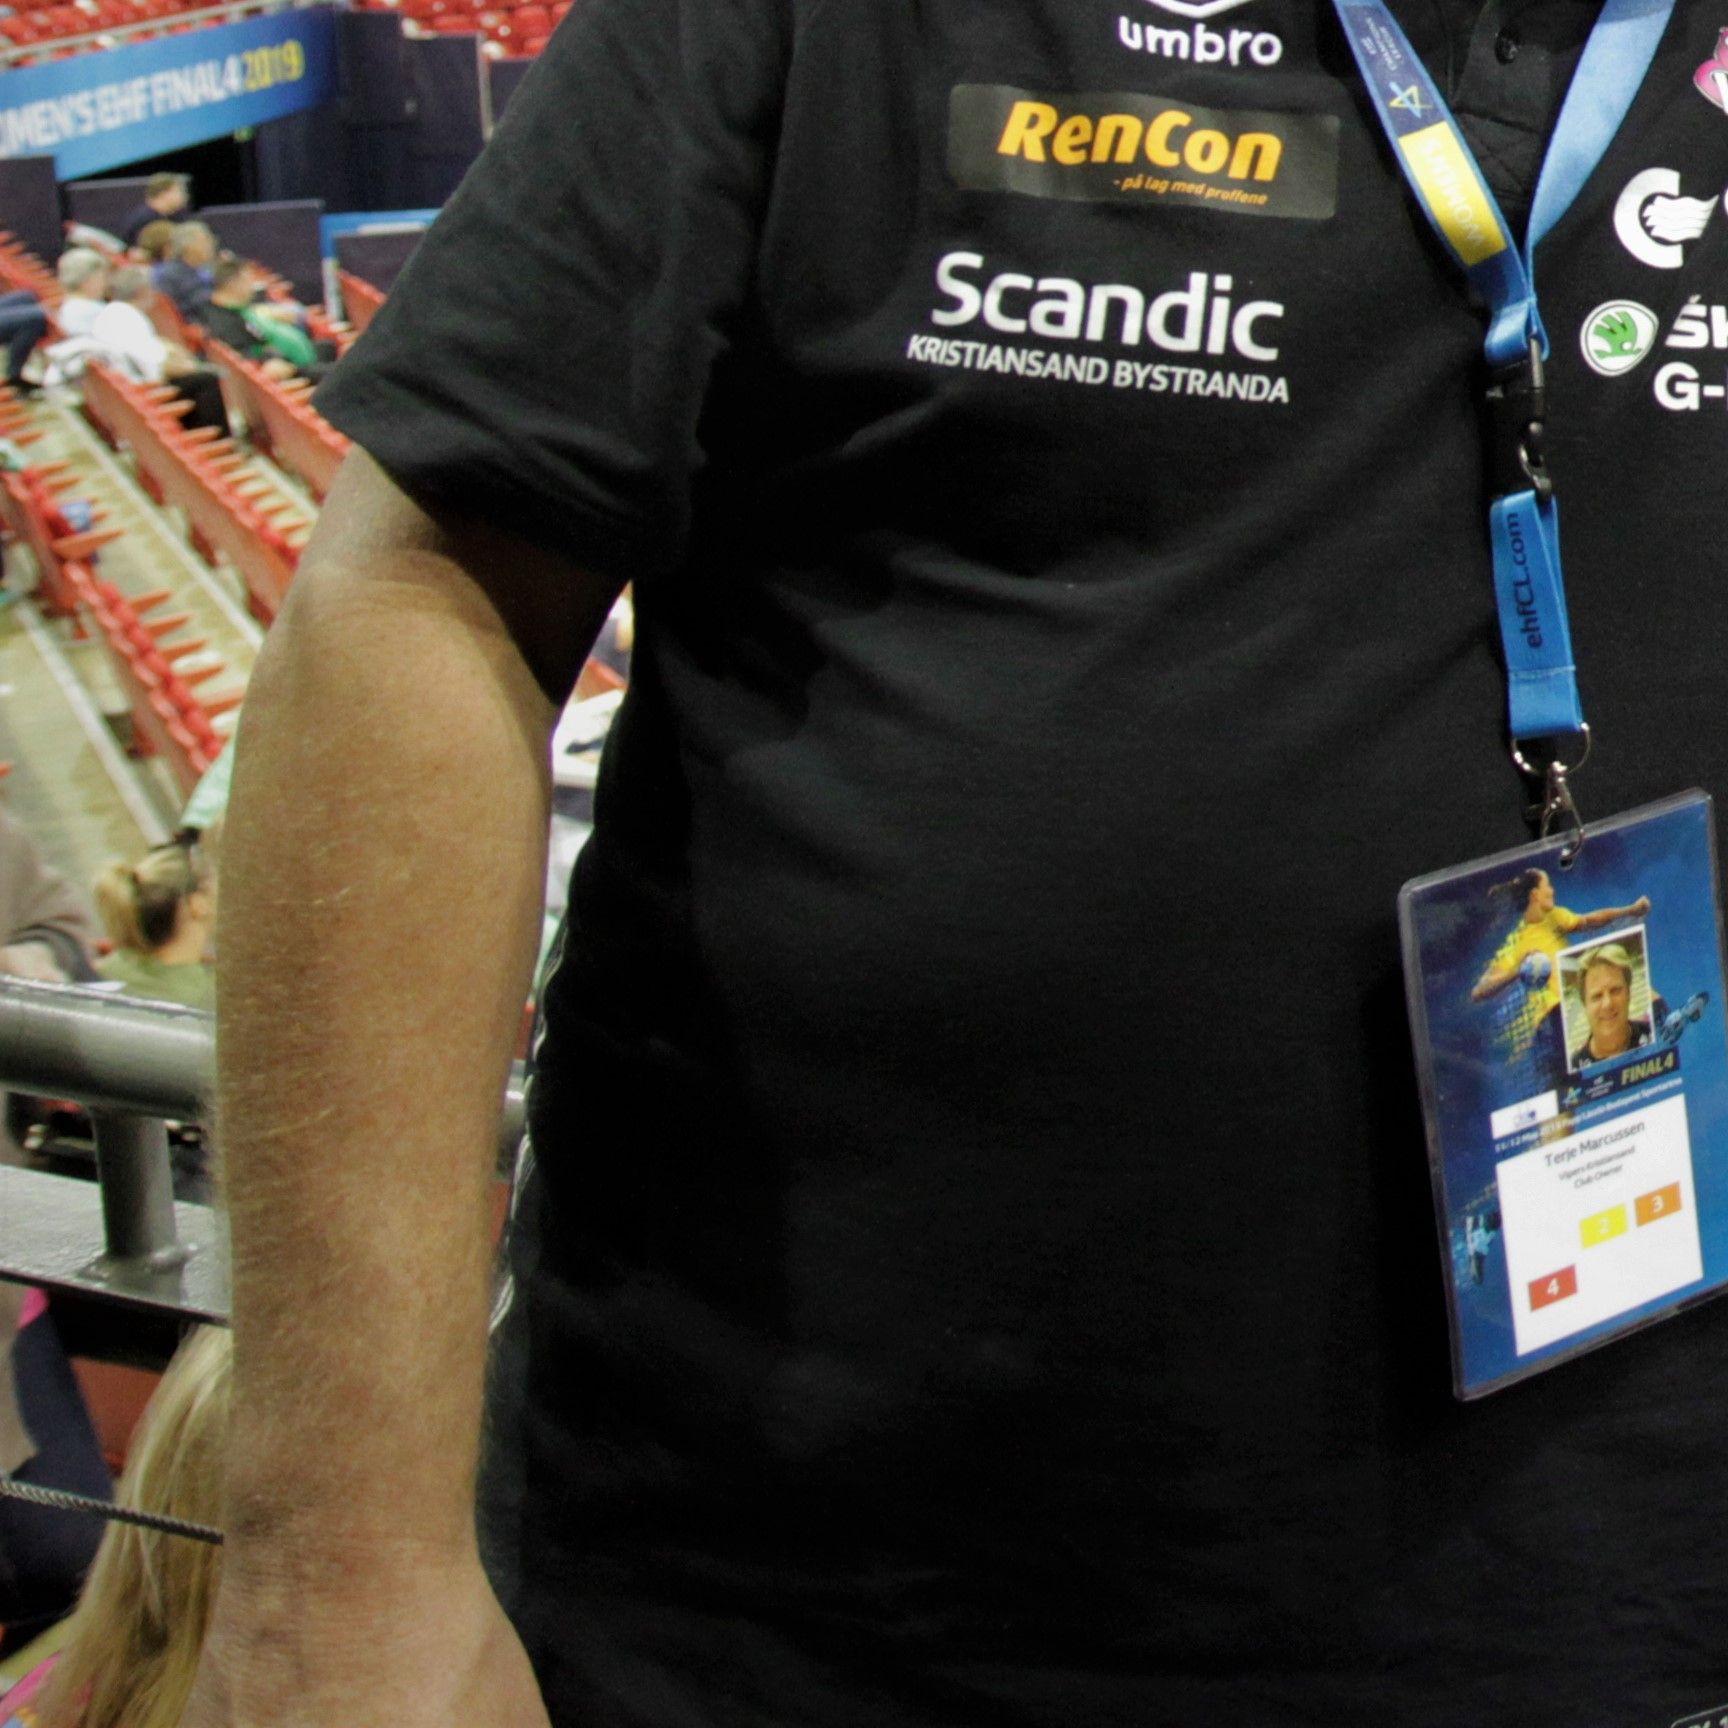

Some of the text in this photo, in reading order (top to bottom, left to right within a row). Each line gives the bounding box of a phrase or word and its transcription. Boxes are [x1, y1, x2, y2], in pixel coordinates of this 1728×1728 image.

[242, 38, 306, 92] 2019
[1117, 15, 1284, 67] umbro
[997, 100, 1283, 182] RenCon
[1144, 175, 1169, 195] lag
[1170, 178, 1206, 197] med
[1205, 184, 1269, 206] proffene
[930, 250, 1285, 363] Scandic
[906, 333, 1290, 404] KRISTIANSAND BYSTRANDA
[1503, 511, 1545, 650] ehfCL.com
[1544, 1144, 1578, 1167] Terje
[1579, 1121, 1646, 1155] Marcussen
[1651, 1193, 1665, 1214] 3
[1544, 1277, 1561, 1297] 4
